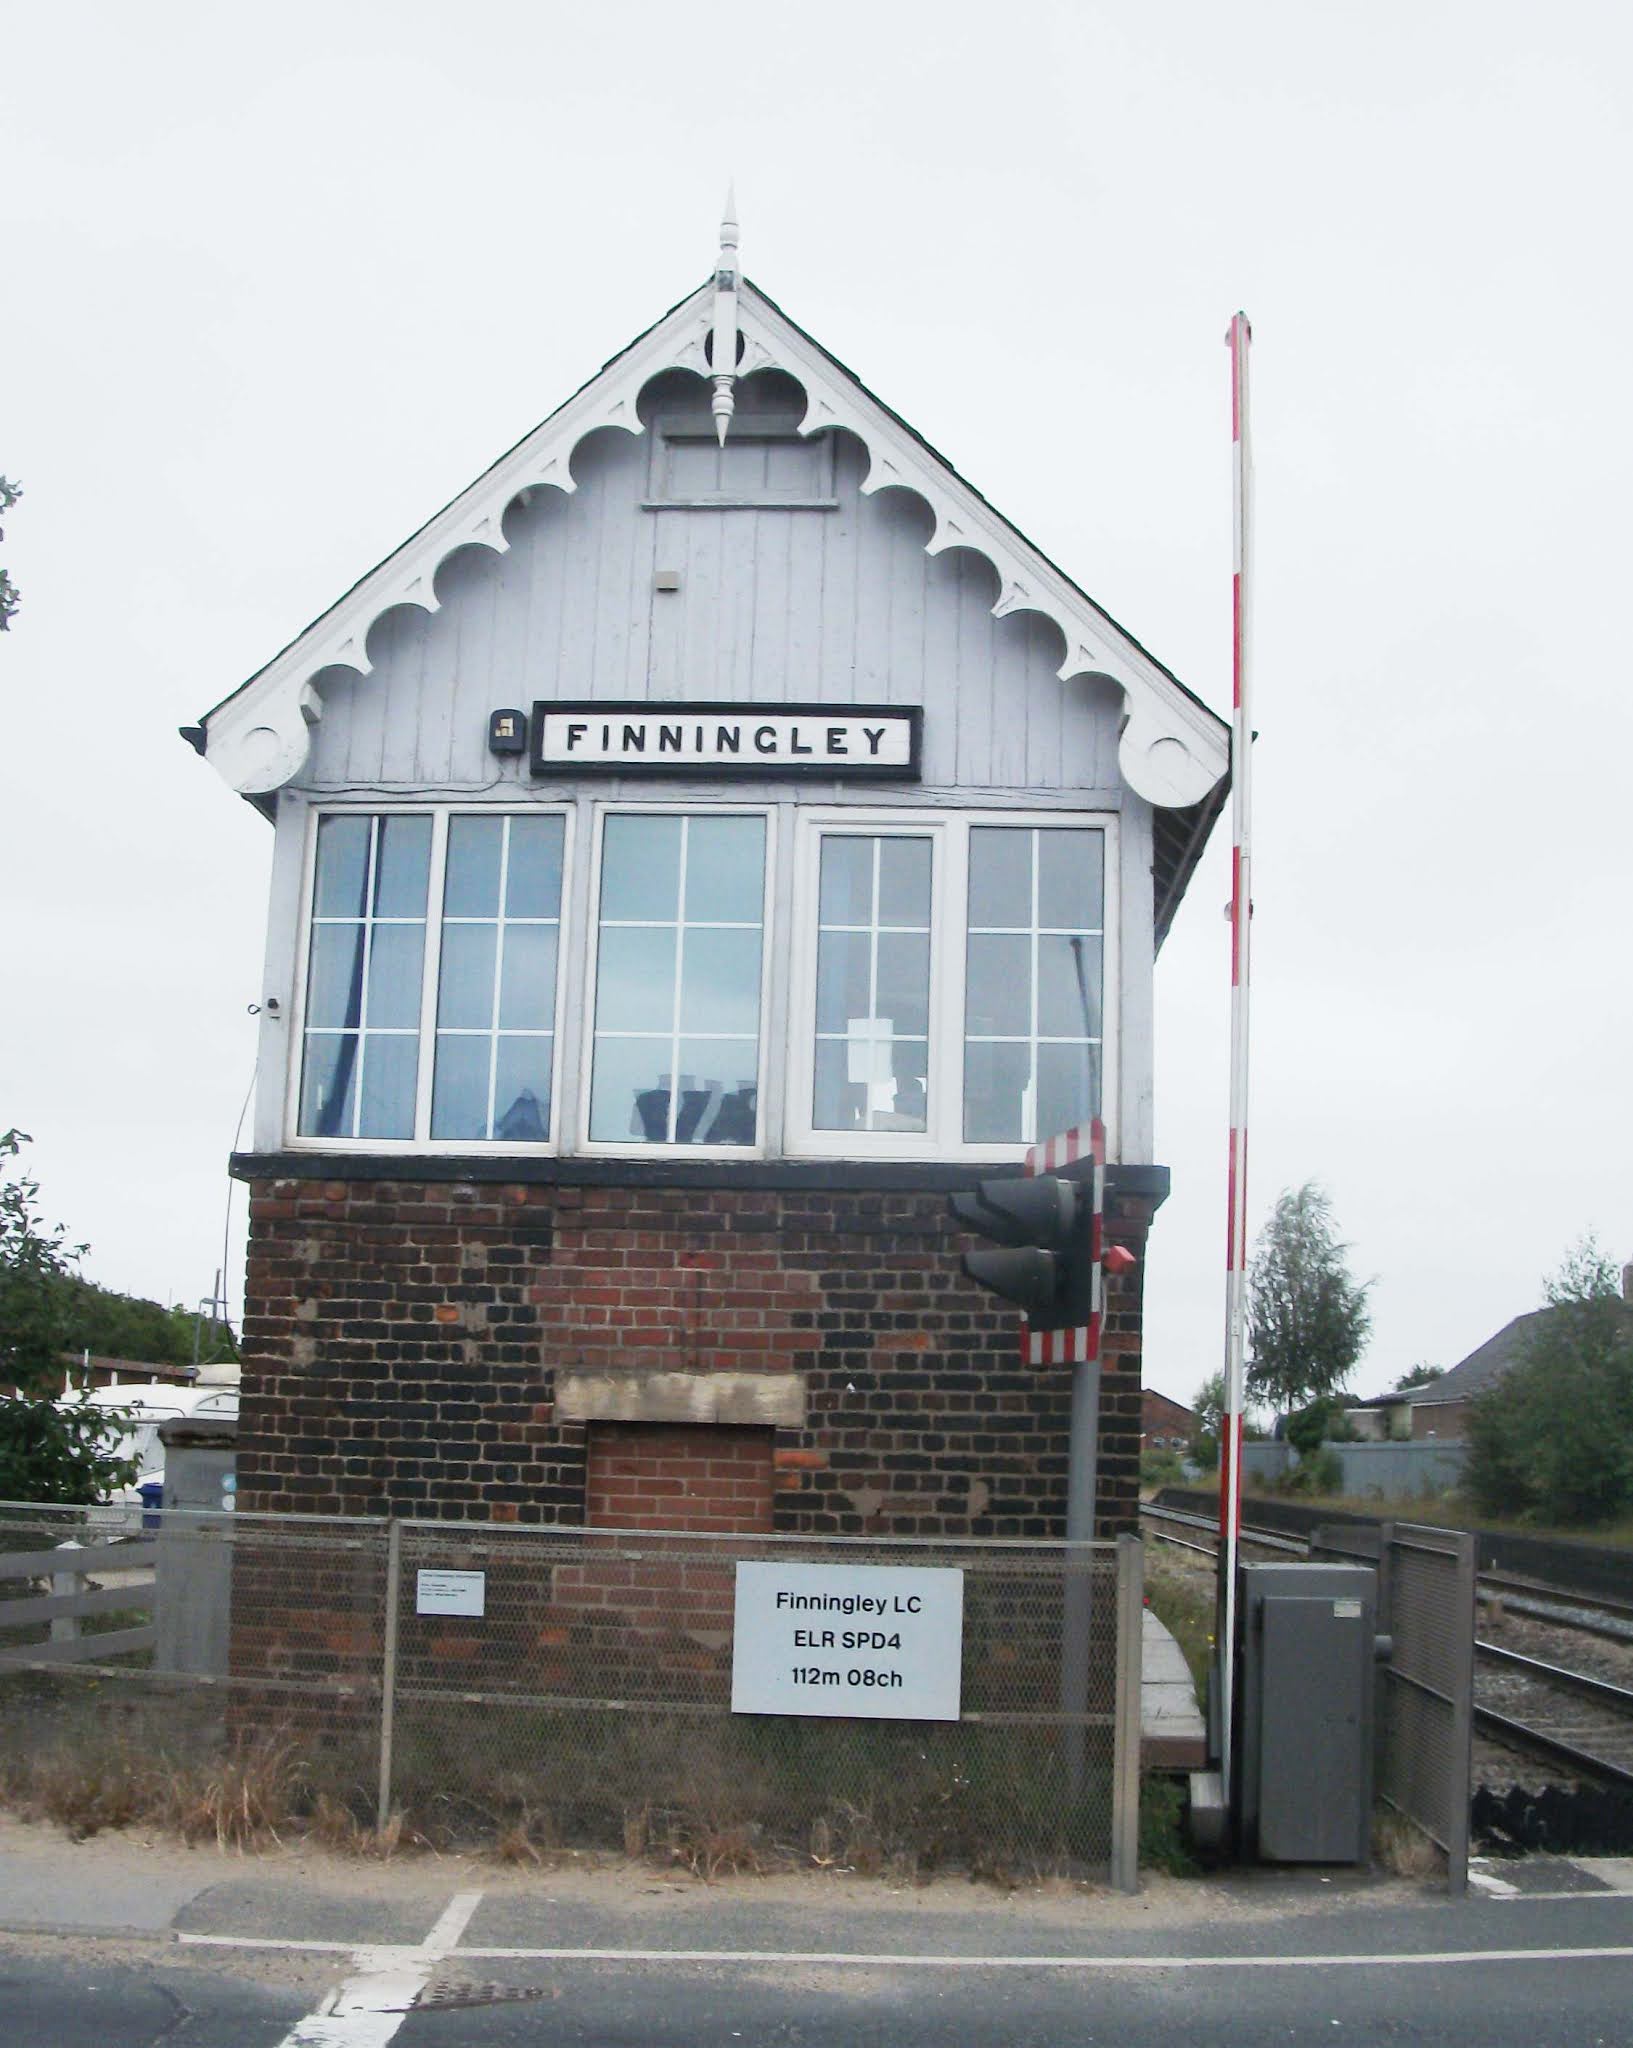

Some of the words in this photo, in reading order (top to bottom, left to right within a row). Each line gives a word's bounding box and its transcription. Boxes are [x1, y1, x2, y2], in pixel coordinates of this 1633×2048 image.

[567, 724, 886, 755] FINNINGLEY
[776, 1592, 887, 1616] Finningley
[894, 1596, 922, 1613] LC
[794, 1630, 835, 1648] ELR
[842, 1631, 901, 1650] SPD4
[792, 1667, 840, 1685] 112m
[847, 1669, 902, 1687] 08ch
